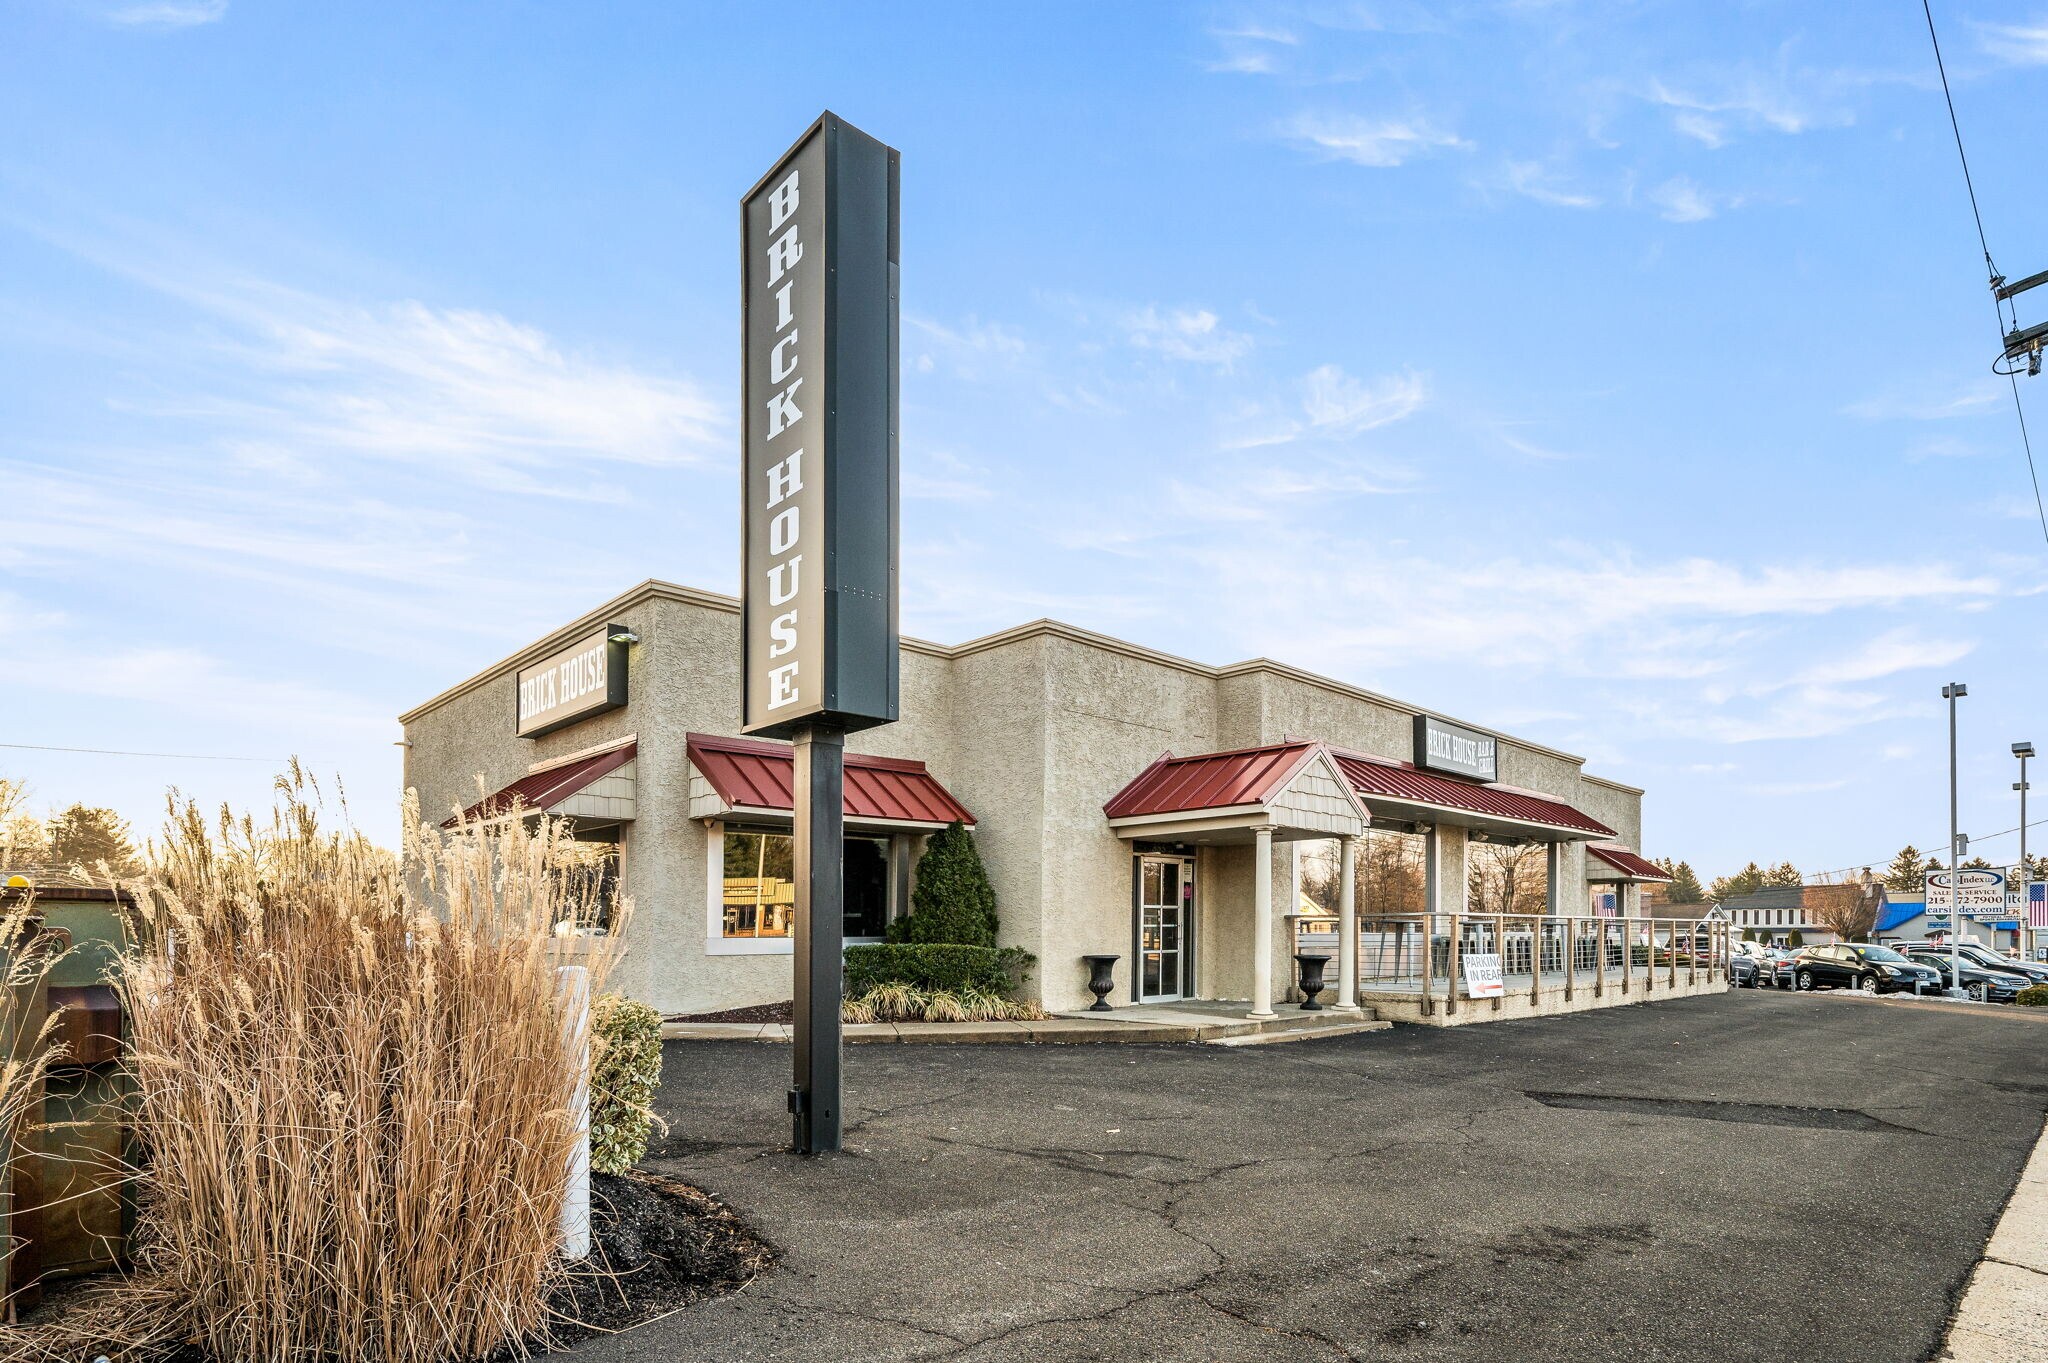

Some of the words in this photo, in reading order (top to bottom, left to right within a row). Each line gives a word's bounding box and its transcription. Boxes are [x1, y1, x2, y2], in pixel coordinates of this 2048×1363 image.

[767, 169, 803, 441] BRICK
[767, 448, 803, 711] HOUSE
[520, 667, 557, 720] BRICK
[560, 644, 605, 704] HOUSE
[1428, 728, 1451, 760] BRICK
[1453, 736, 1477, 767] HOUSE
[1938, 875, 1984, 885] CaIndex
[1927, 896, 2003, 905] 215-72-7900
[1927, 905, 2003, 914] carsidex.com
[1470, 970, 1480, 981] IN
